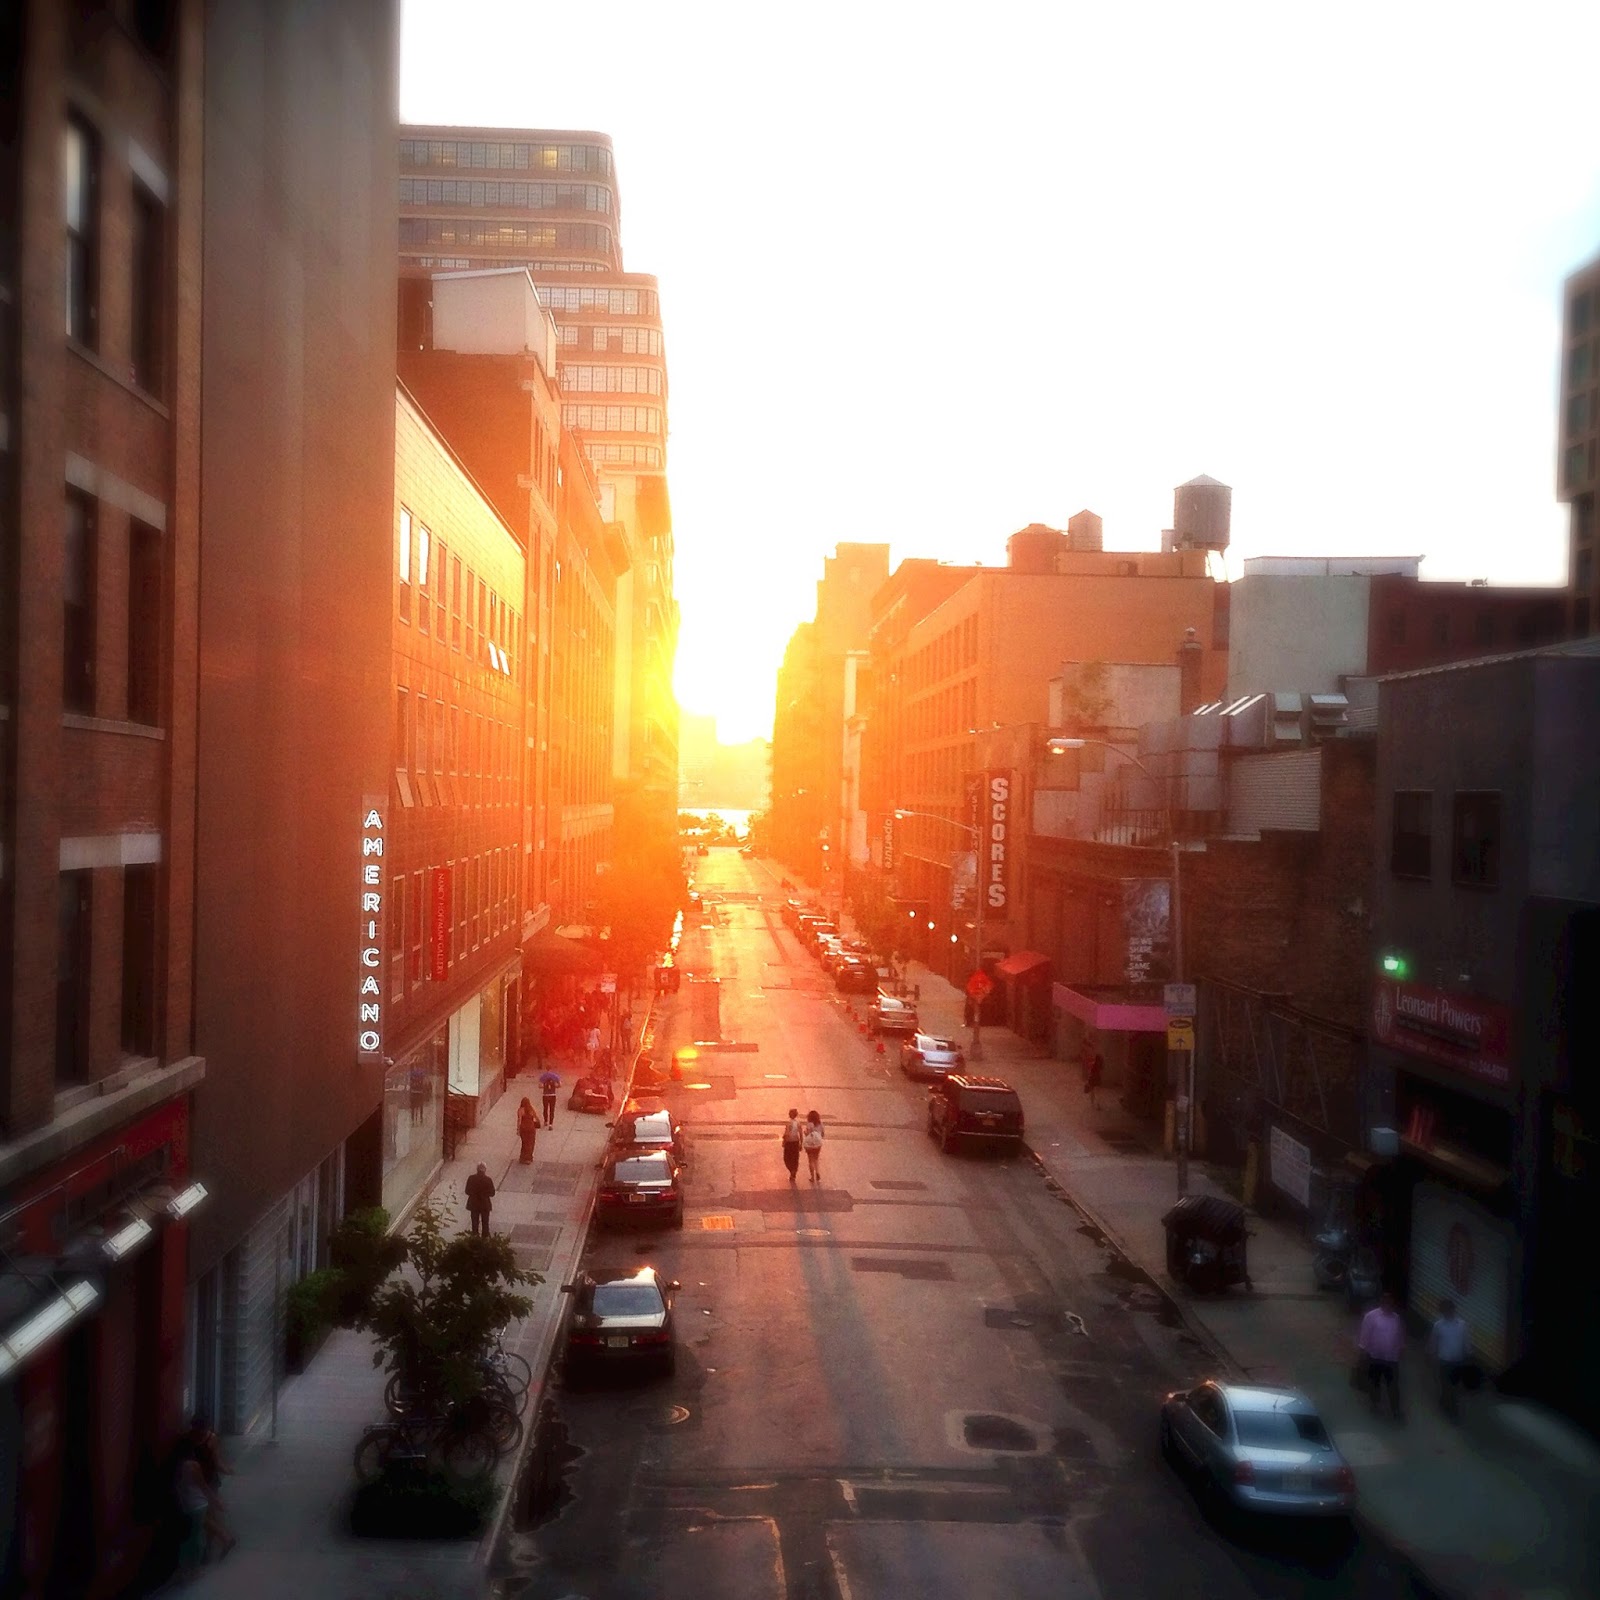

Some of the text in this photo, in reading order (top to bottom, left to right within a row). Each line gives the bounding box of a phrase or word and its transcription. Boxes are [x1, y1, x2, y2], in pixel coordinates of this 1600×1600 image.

[882, 818, 894, 869] aperture
[988, 777, 1008, 907] SCORES
[360, 809, 383, 1051] AMERICANO
[436, 873, 445, 975] NANCY HOFFMAN GALLERY
[1395, 986, 1438, 1022] Leonard
[1440, 999, 1482, 1036] Powers
